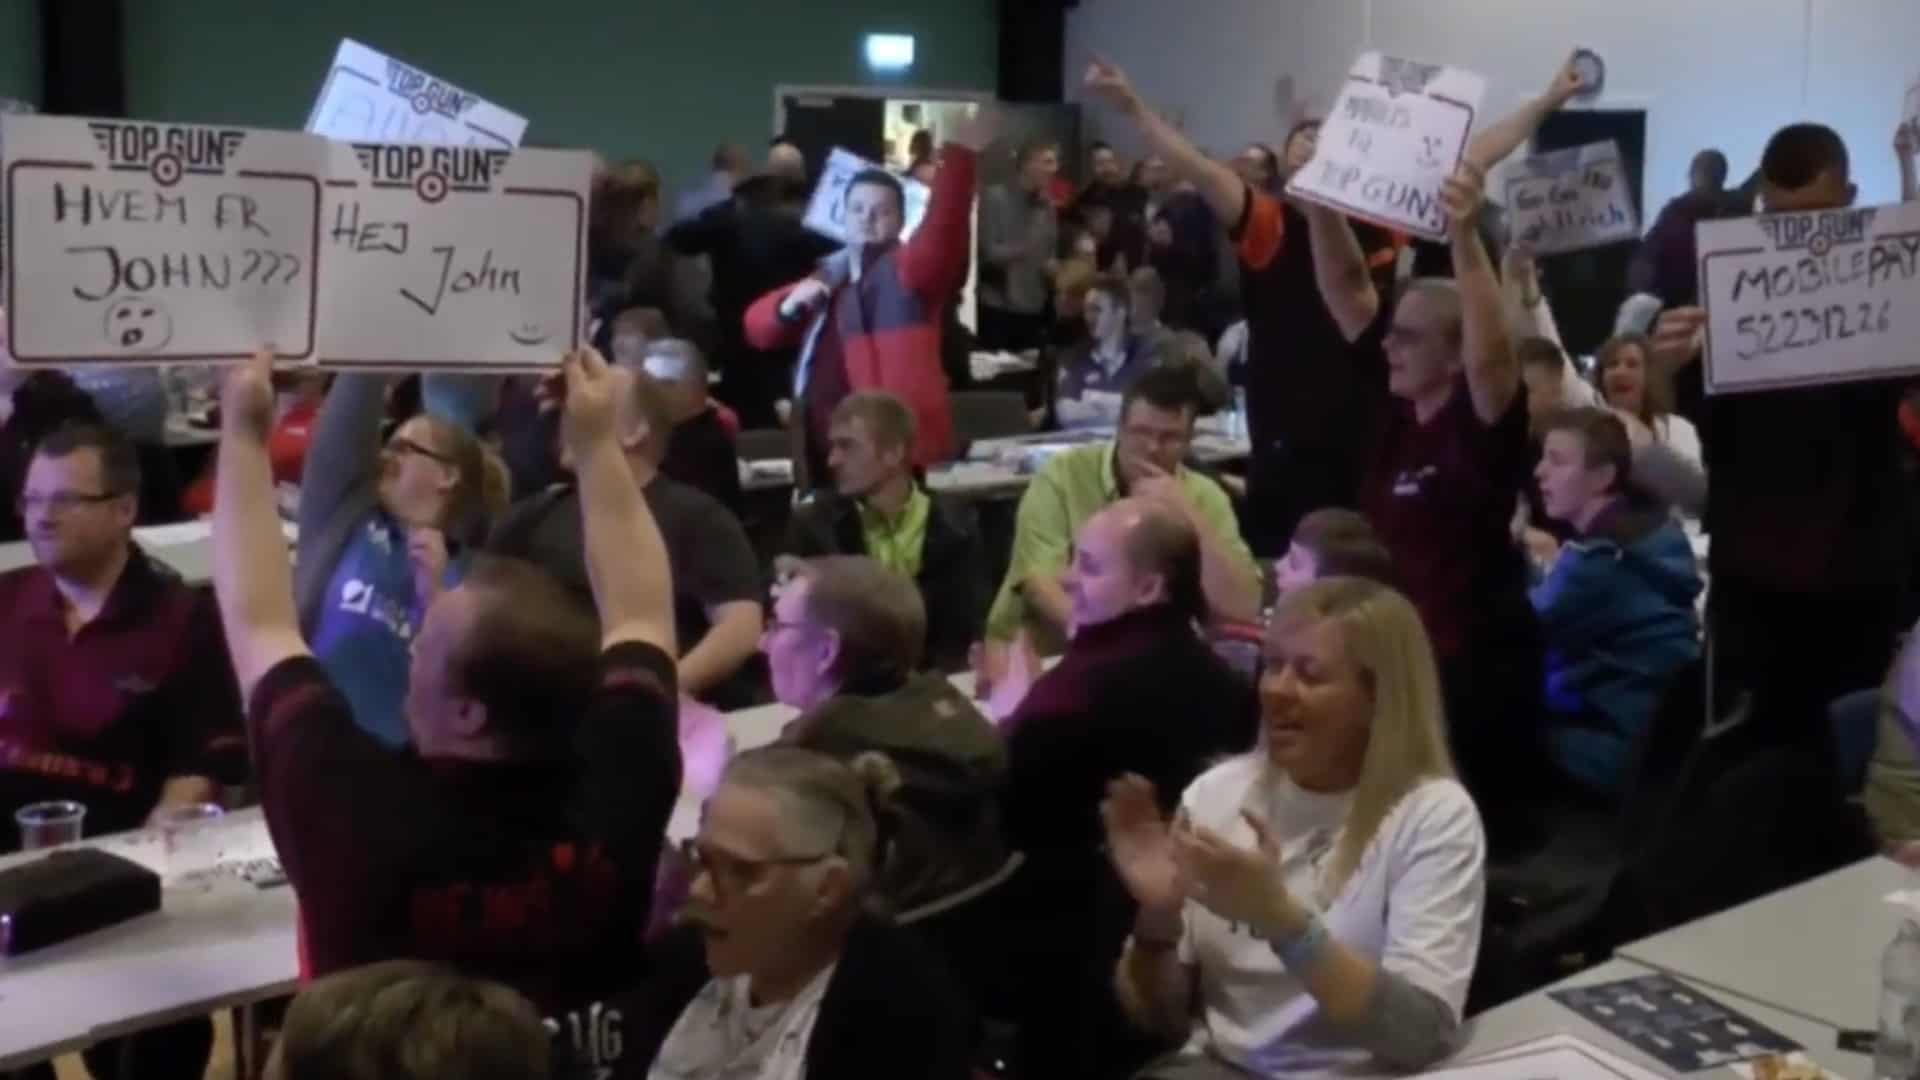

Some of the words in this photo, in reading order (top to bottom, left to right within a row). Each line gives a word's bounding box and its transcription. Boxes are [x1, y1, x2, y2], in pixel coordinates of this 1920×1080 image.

[104, 124, 159, 162] TOP
[163, 127, 226, 165] GUN
[369, 145, 424, 181] TOP
[430, 147, 491, 184] GUN
[53, 181, 188, 227] HVEM
[330, 202, 409, 254] HEJ
[1772, 216, 1812, 246] TOP
[1818, 208, 1866, 240] GUN
[399, 245, 521, 316] John
